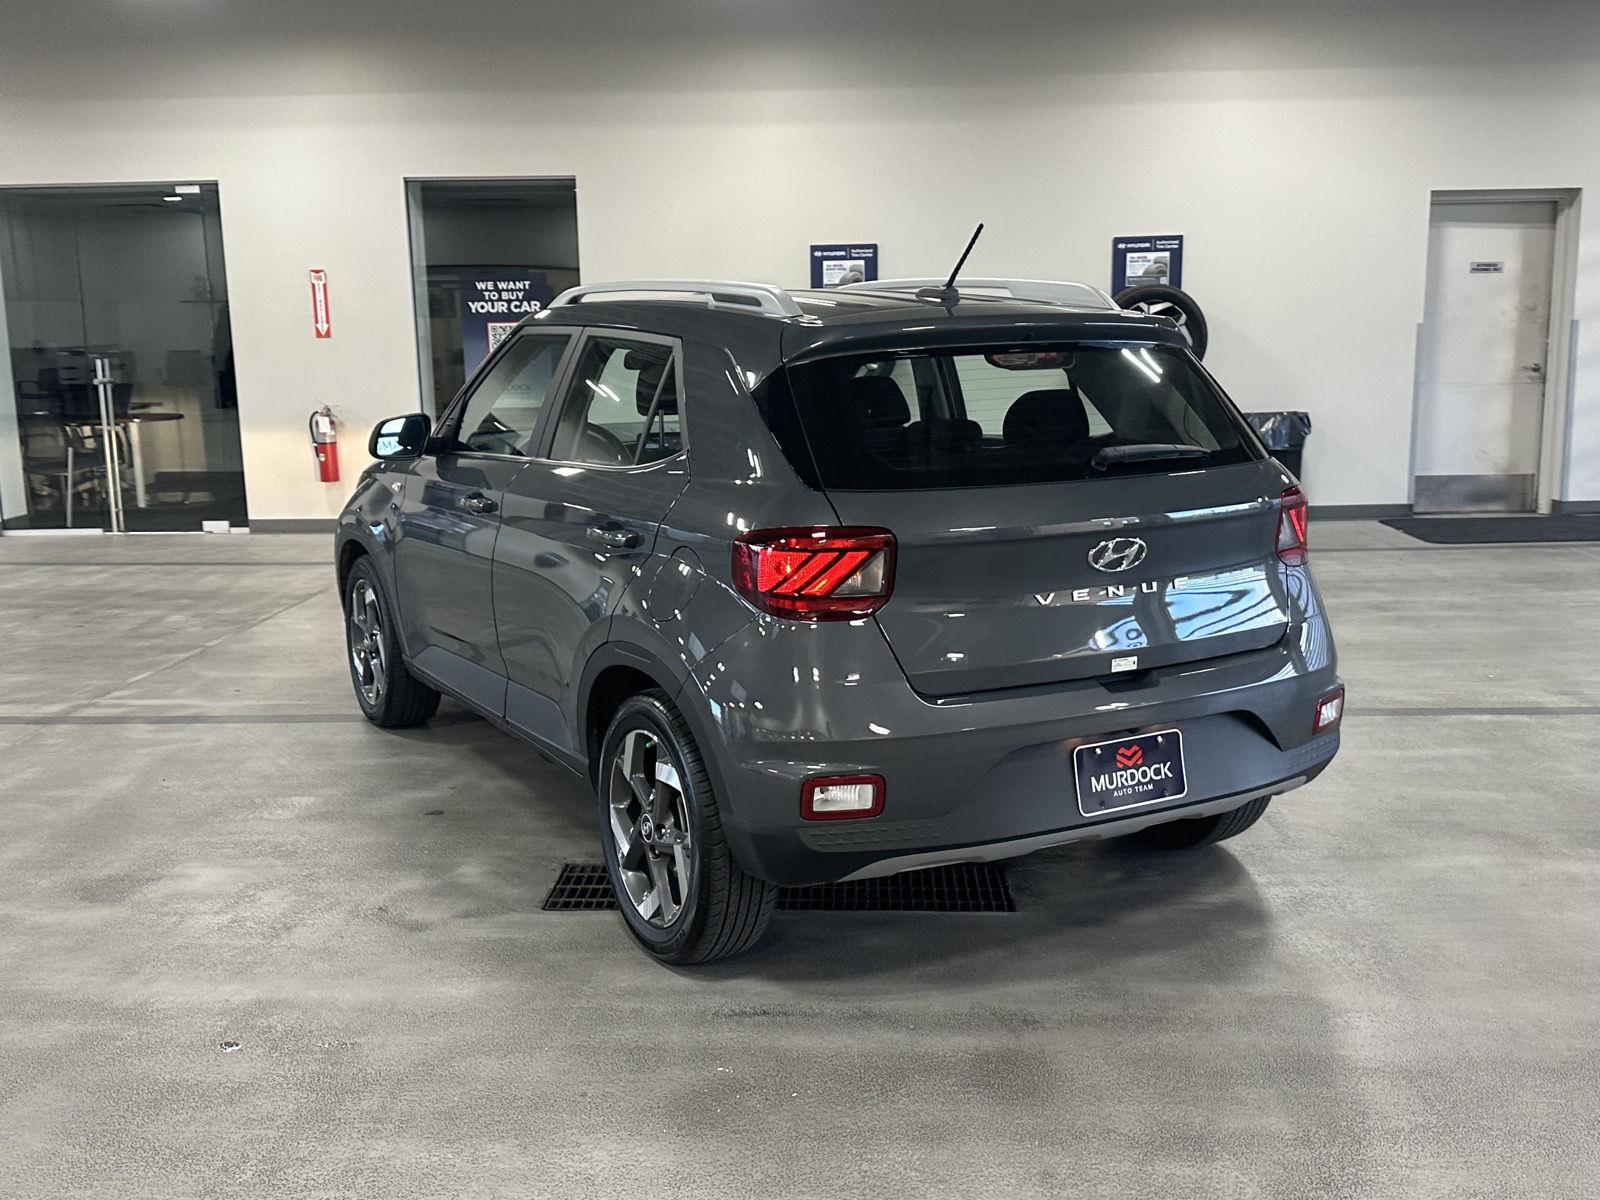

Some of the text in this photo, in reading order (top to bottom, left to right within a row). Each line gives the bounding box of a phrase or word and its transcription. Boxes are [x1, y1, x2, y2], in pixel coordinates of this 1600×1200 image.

[475, 280, 531, 291] WE WANT
[483, 291, 524, 300] TO BUY
[468, 300, 541, 313] YOUR CAR
[1090, 761, 1173, 793] MURDOCK
[1113, 783, 1154, 797] AUTO TEAM
